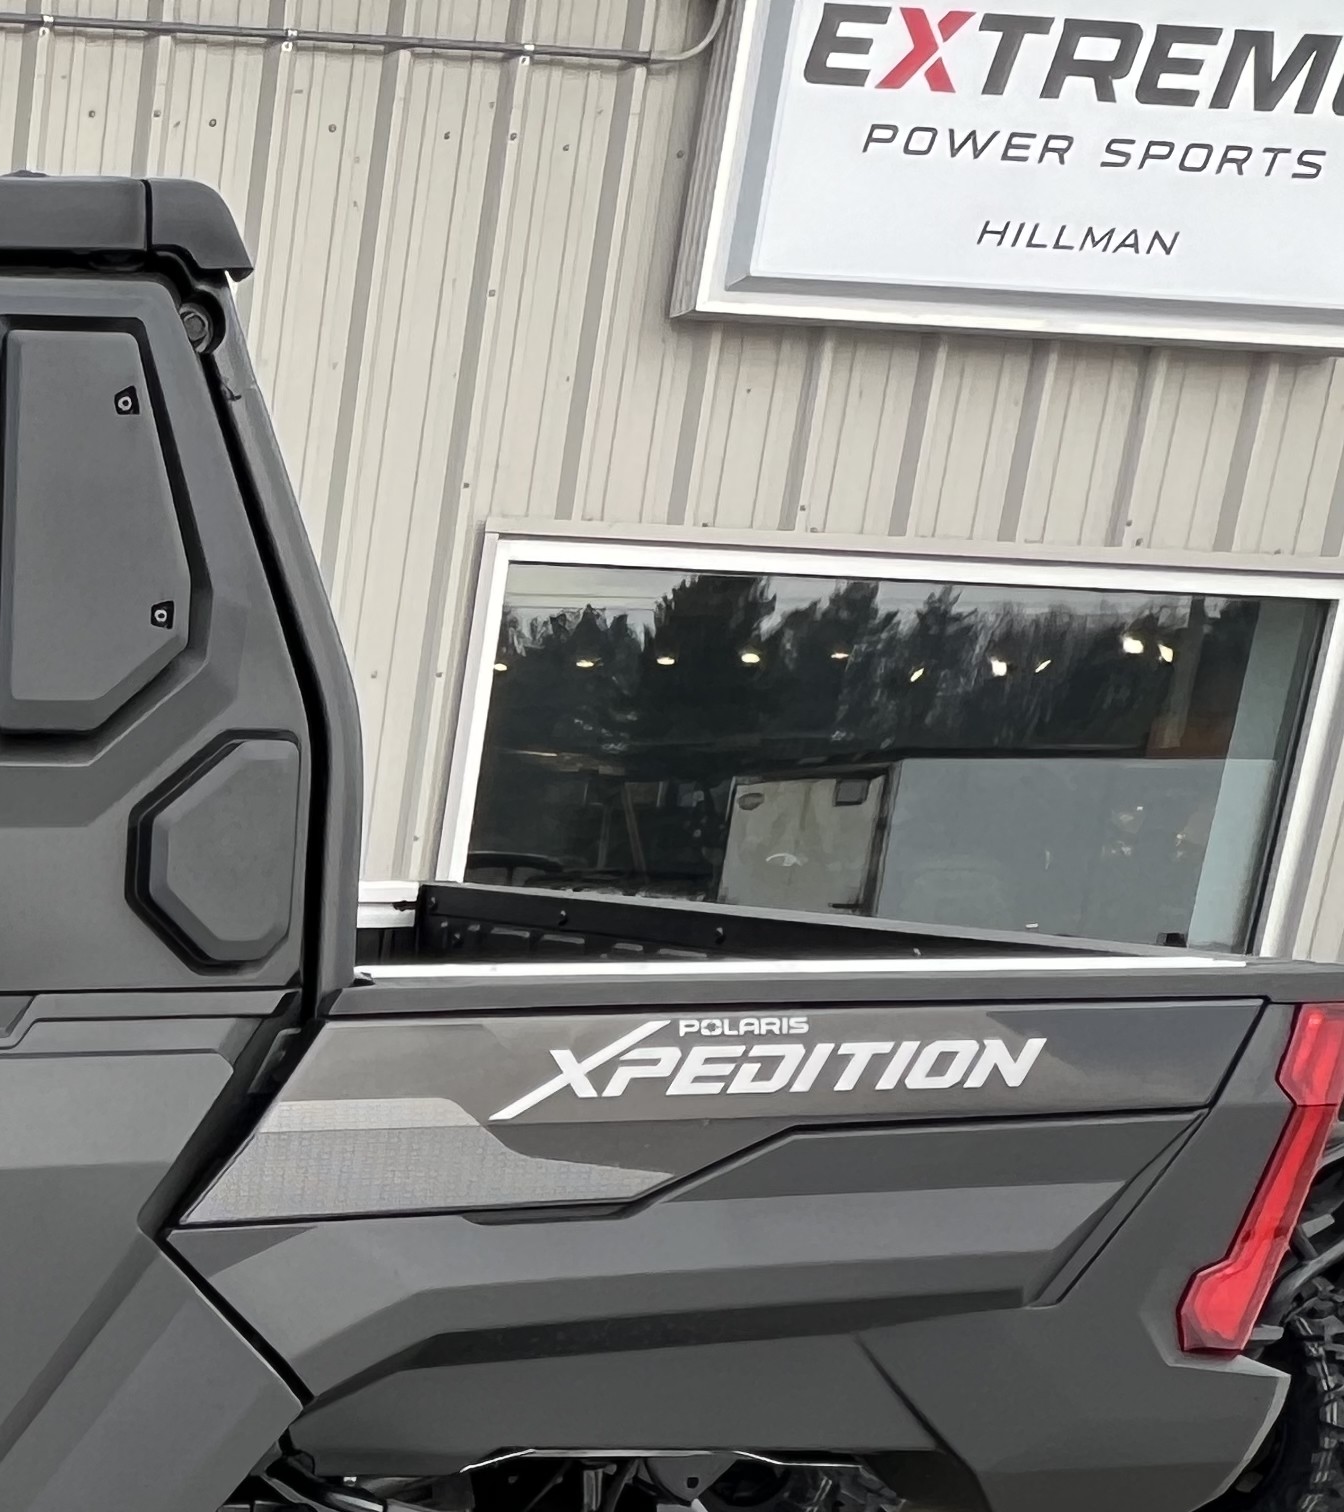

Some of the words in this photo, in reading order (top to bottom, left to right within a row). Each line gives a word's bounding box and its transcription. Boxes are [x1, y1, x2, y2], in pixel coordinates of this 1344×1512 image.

[803, 2, 1344, 117] EXTREM
[862, 123, 1074, 165] POWER
[1100, 138, 1327, 180] SPORTS
[976, 220, 1181, 256] HILLMAN
[678, 1016, 810, 1037] POLARIS
[489, 1019, 1048, 1121] XPEDITION
